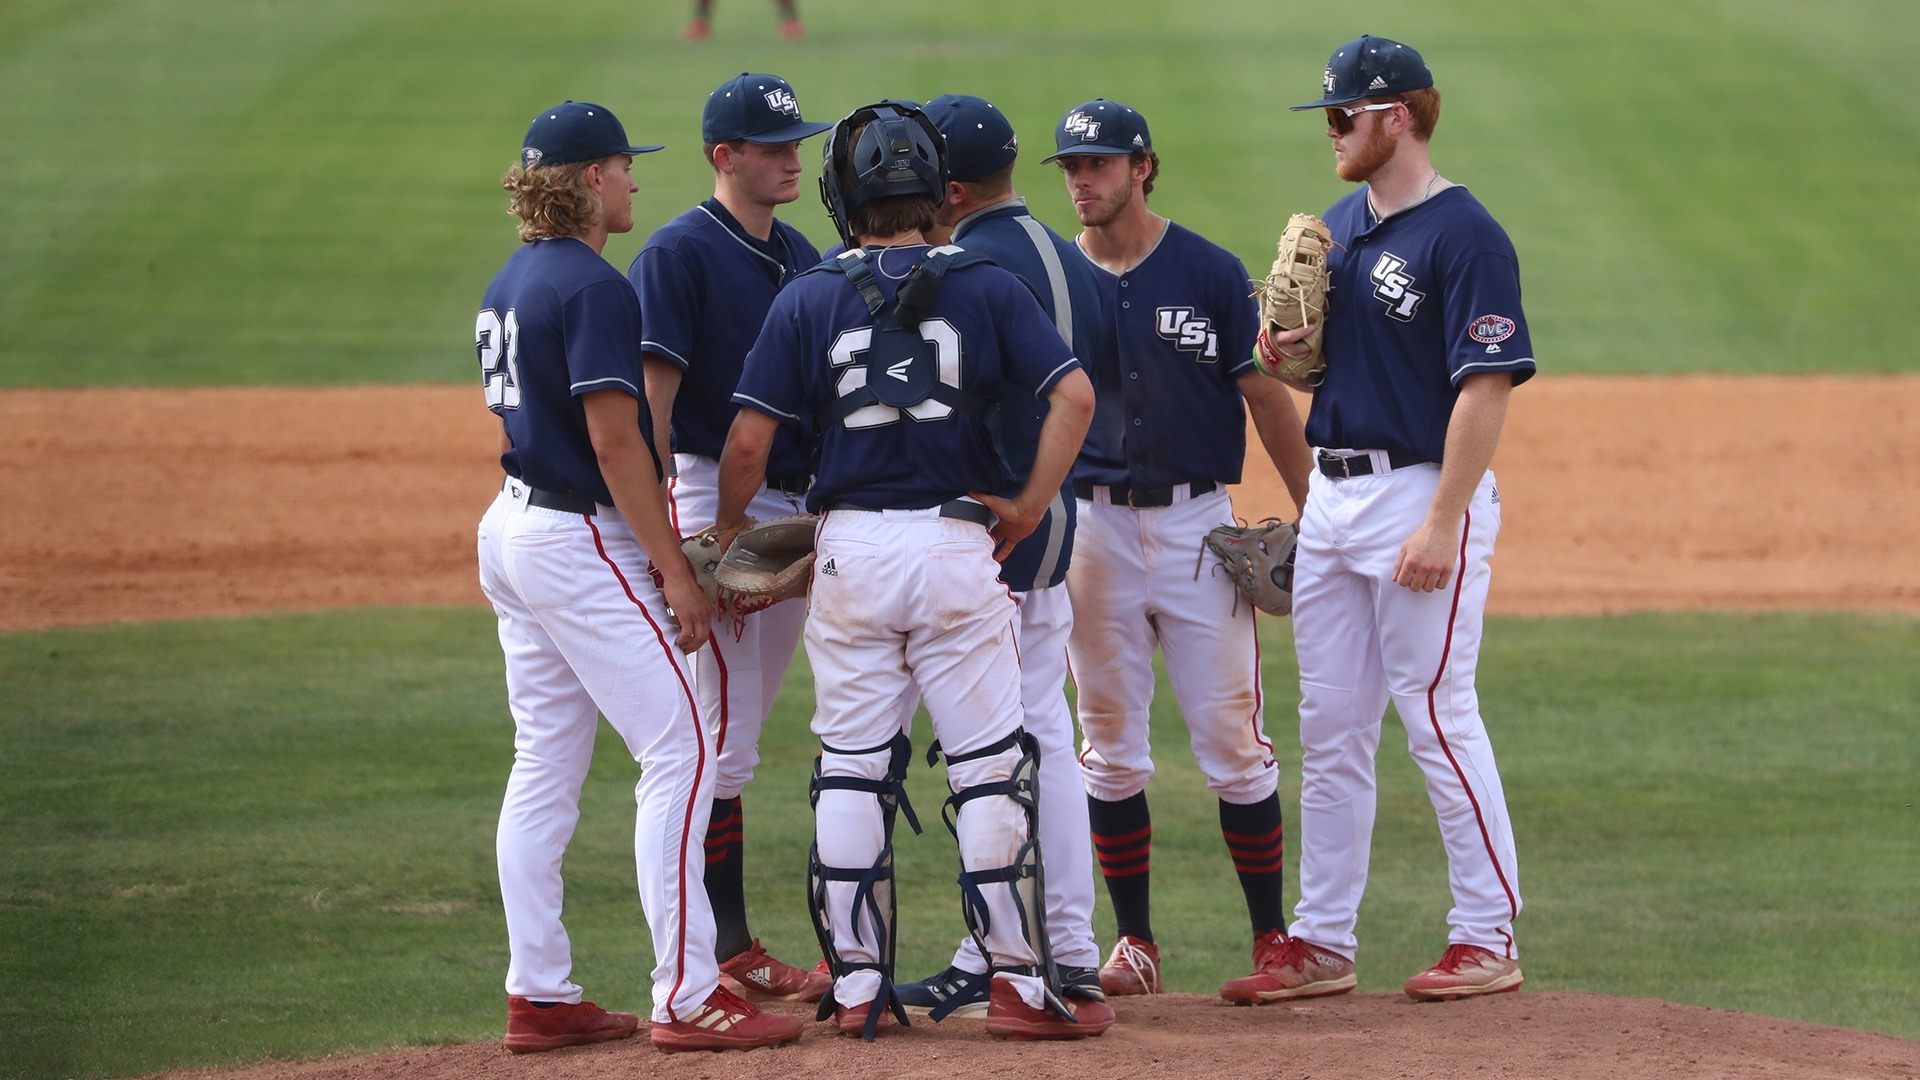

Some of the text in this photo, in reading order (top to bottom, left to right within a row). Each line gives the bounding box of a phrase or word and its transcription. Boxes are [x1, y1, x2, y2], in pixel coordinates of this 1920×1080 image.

[766, 90, 800, 117] USI
[1065, 113, 1099, 139] USI
[1372, 253, 1423, 319] USI
[1158, 308, 1218, 360] USI
[475, 308, 523, 410] 23
[746, 971, 772, 989] adidas
